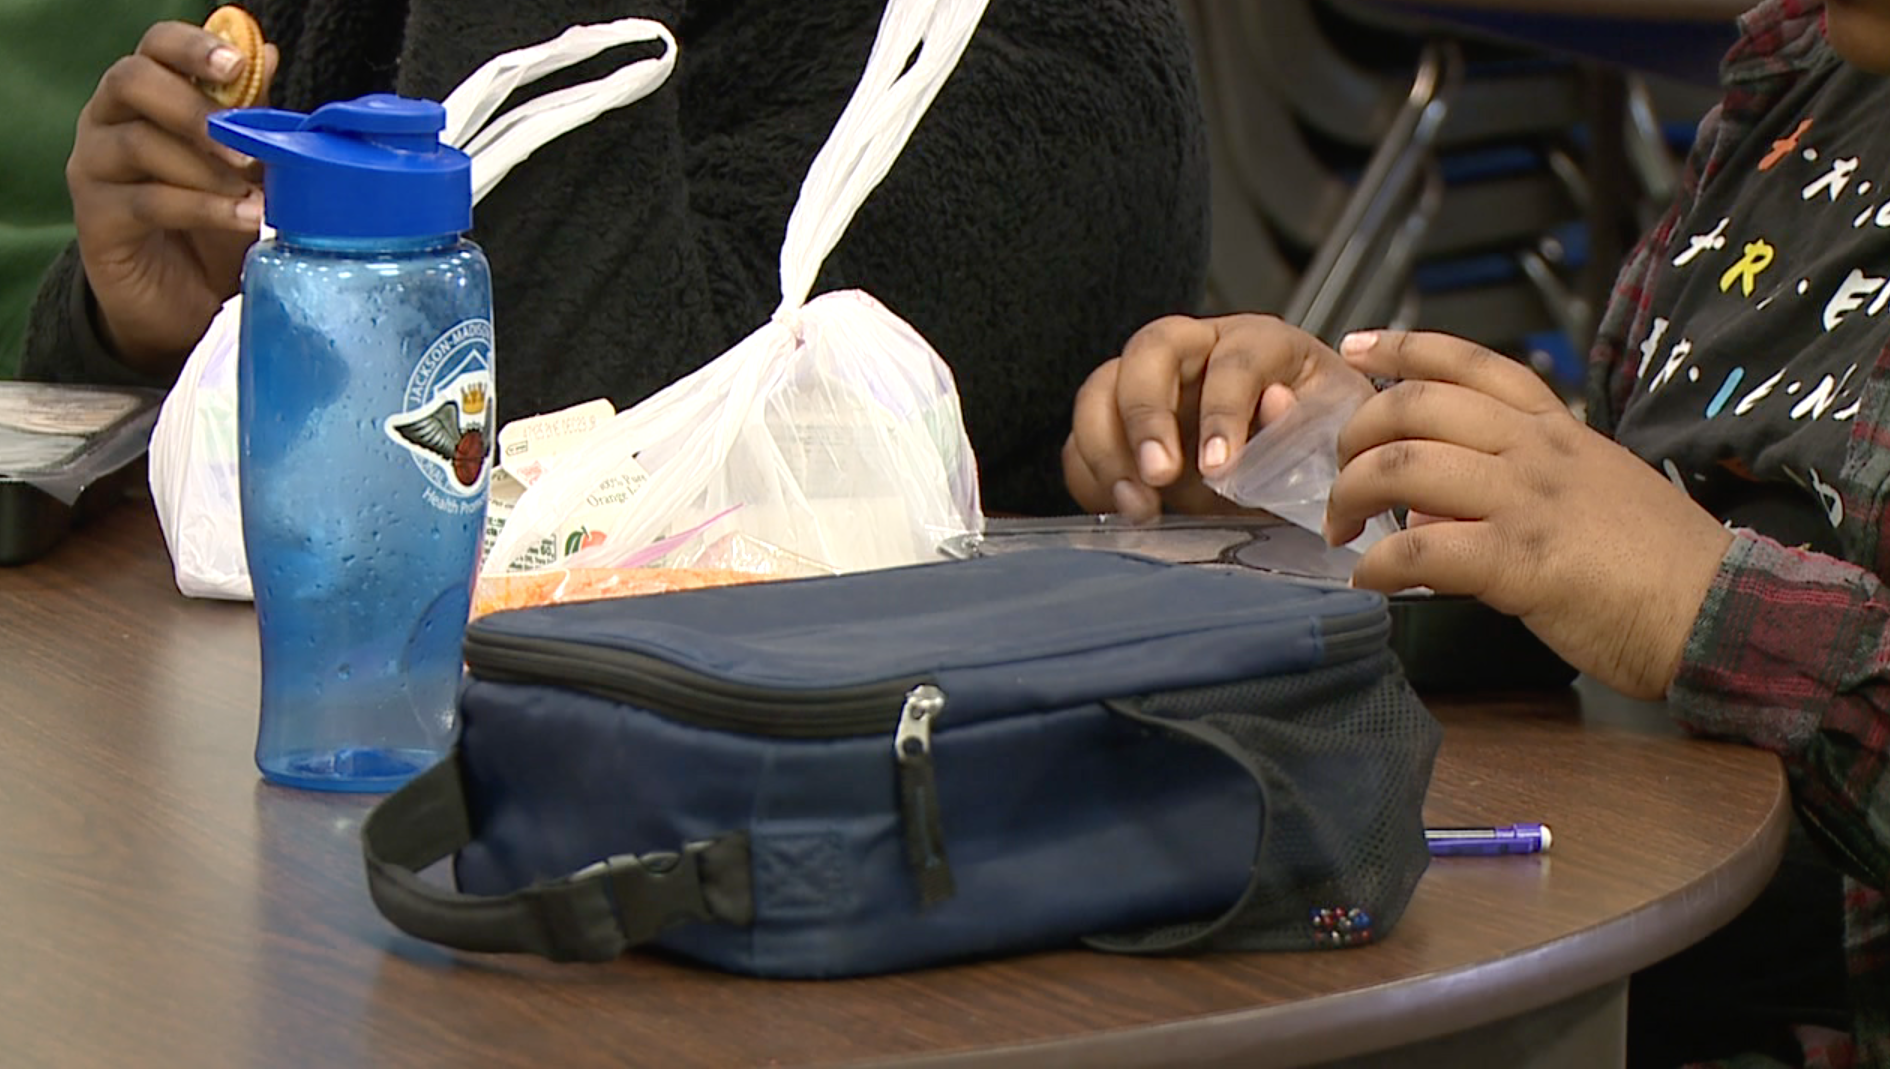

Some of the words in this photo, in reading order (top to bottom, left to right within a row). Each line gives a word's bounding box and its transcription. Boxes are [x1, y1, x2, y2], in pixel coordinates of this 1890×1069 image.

[410, 323, 489, 403] JACKSON-MADISO
[421, 486, 458, 514] Health
[586, 491, 629, 507] Orange
